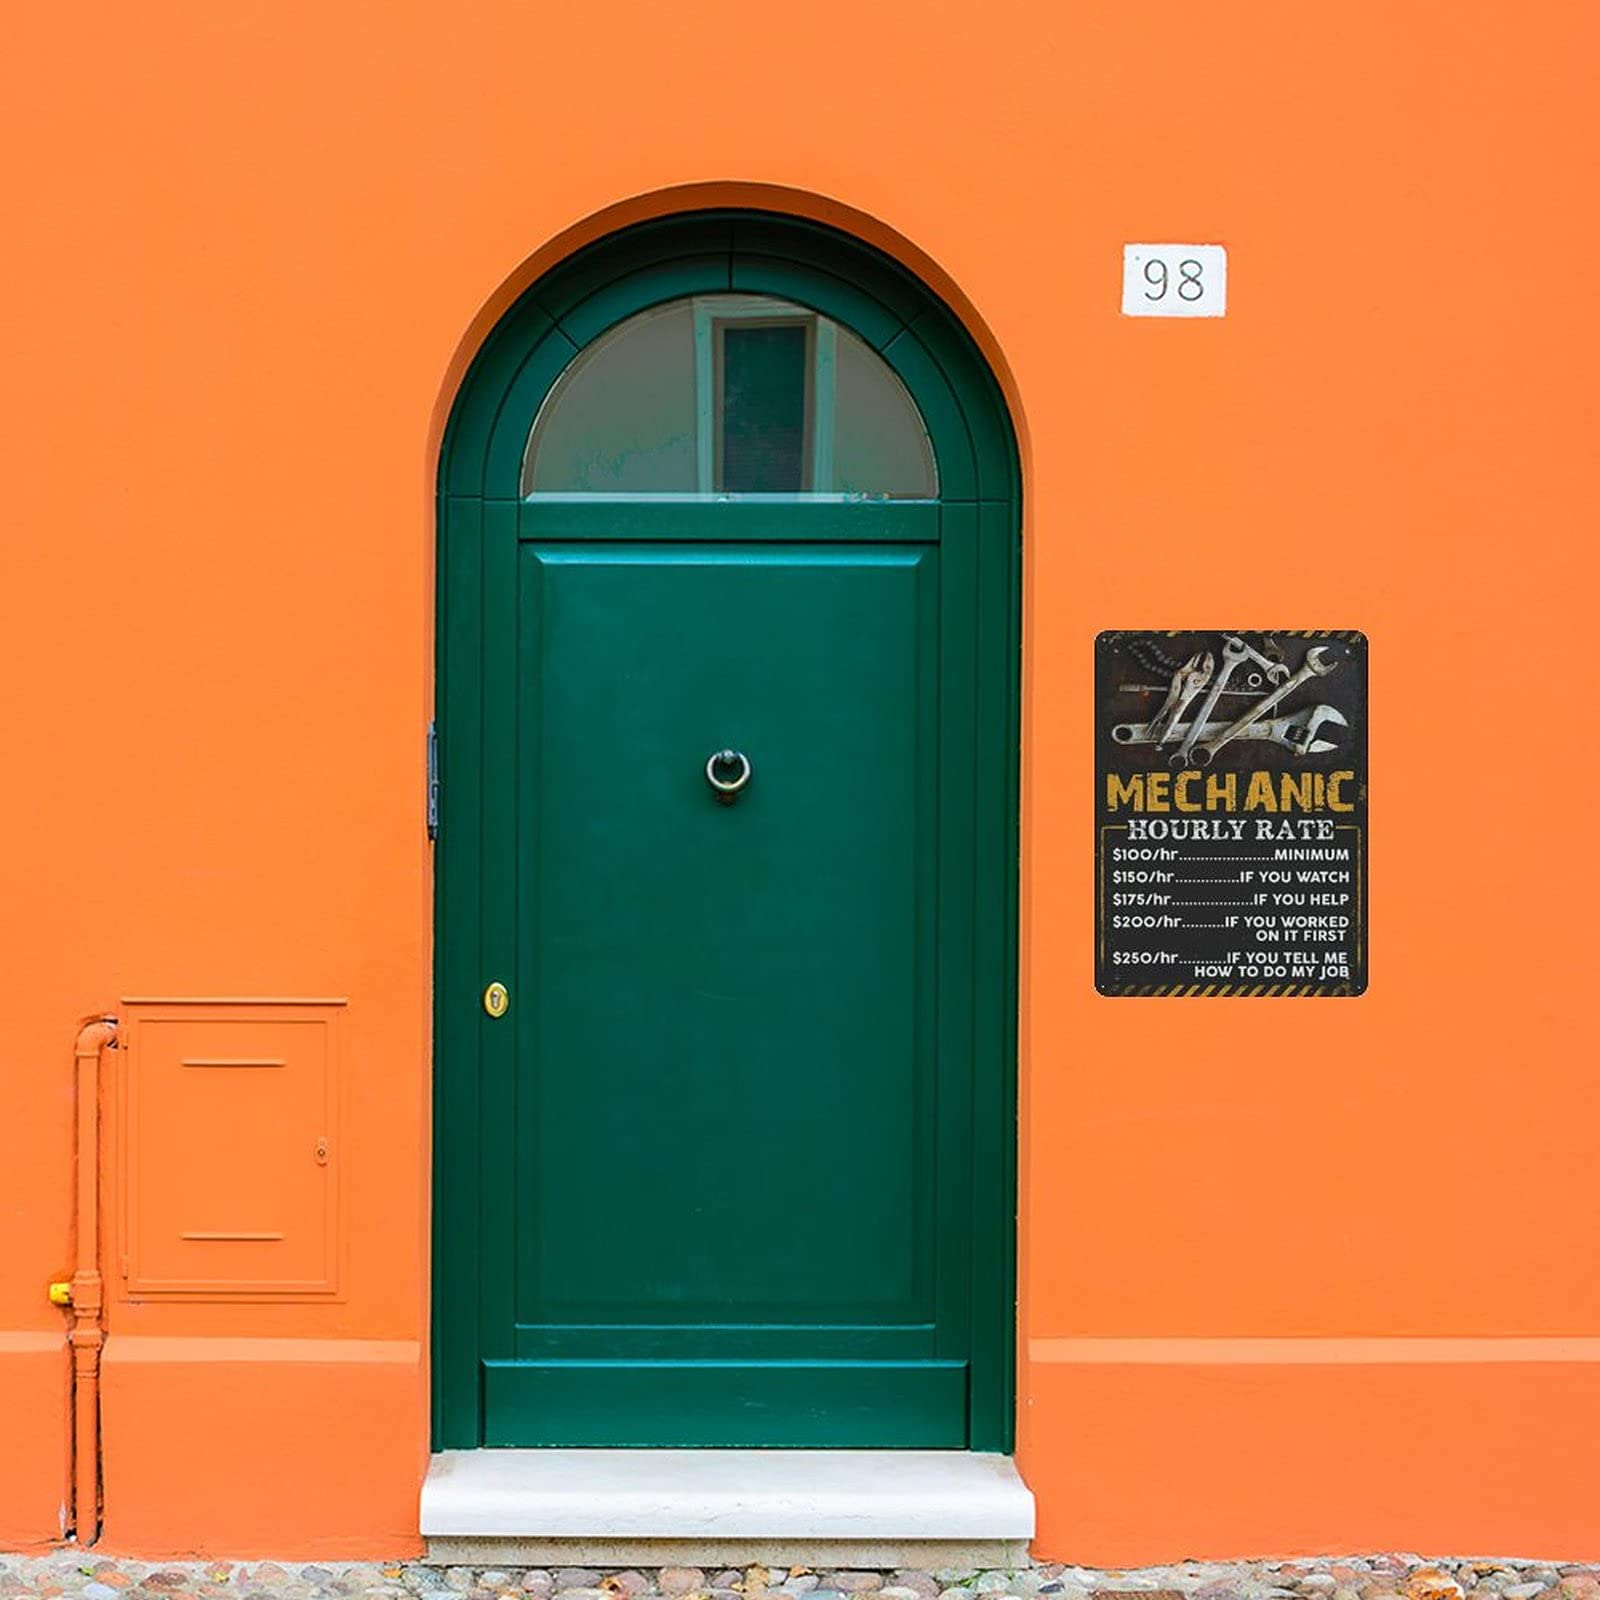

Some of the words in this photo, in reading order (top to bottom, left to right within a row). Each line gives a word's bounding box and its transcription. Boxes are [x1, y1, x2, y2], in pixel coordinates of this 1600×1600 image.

[1144, 259, 1204, 301] 98
[1106, 770, 1355, 813] MECHANIC
[1127, 819, 1247, 841] HOURLY
[1255, 819, 1334, 841] RATE
[1112, 848, 1179, 862] $100/hr
[1274, 849, 1349, 861] MINIMUM
[1112, 870, 1175, 884] $150/hr
[1240, 871, 1254, 883] IF
[1259, 871, 1292, 883] YOU
[1296, 871, 1350, 883] WATCH
[1112, 892, 1172, 907] $175/hr
[1254, 894, 1268, 906] IF
[1272, 894, 1305, 906] YOU
[1310, 894, 1349, 906] HELP
[1112, 915, 1182, 929] $200/hr
[1225, 916, 1239, 928] IF
[1243, 916, 1276, 928] YOU
[1280, 916, 1349, 928] WORKED
[1256, 930, 1280, 942] ON
[1284, 930, 1298, 942] IT
[1303, 930, 1346, 942] FIRST
[1112, 951, 1179, 966] $250/hr
[1227, 952, 1241, 964] IF
[1245, 952, 1279, 964] YOU
[1282, 952, 1319, 964] TELL
[1324, 952, 1347, 964] ME
[1194, 966, 1233, 978] HOW
[1238, 966, 1259, 978] TO
[1263, 966, 1287, 978] DO
[1291, 966, 1315, 978] MY
[1318, 966, 1349, 980] JOB
